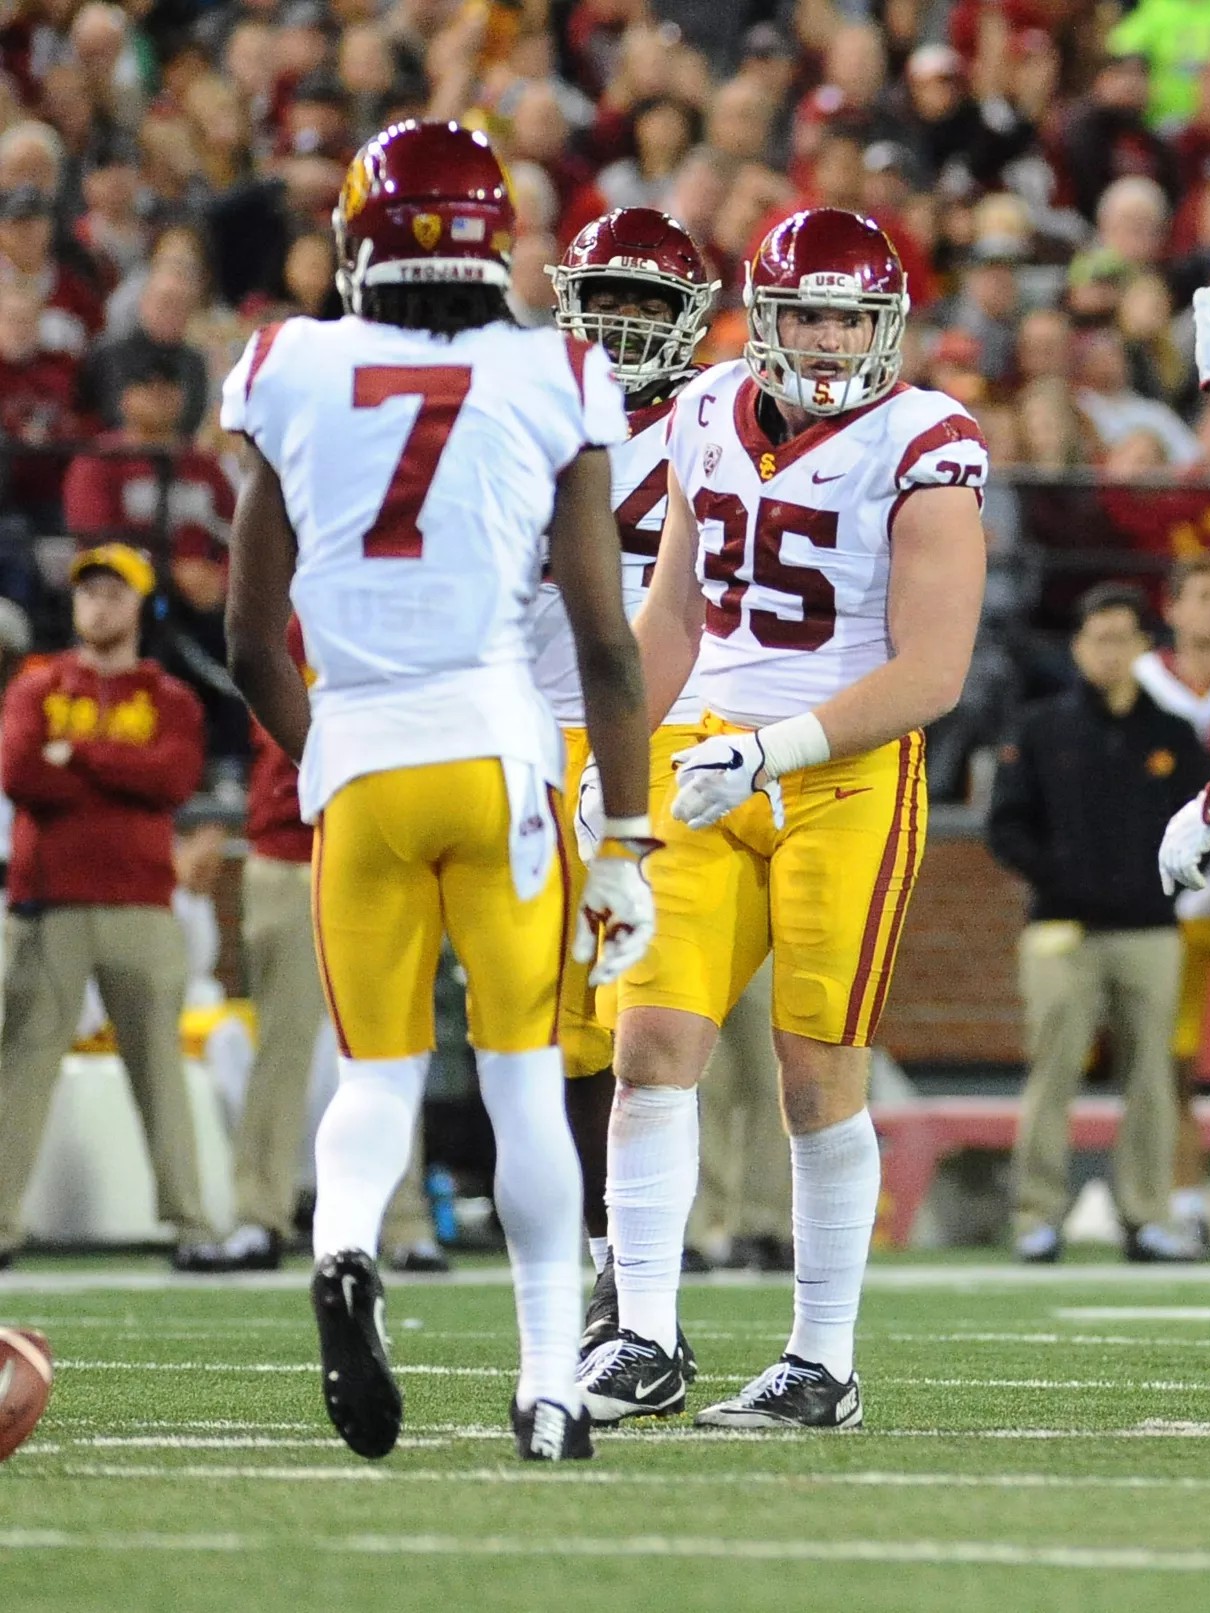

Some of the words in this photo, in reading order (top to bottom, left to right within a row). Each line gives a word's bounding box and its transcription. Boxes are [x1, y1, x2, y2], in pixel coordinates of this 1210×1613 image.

[400, 264, 484, 281] TROJANS
[621, 256, 648, 270] USC
[815, 275, 846, 287] USC
[698, 394, 716, 427] C
[352, 365, 473, 558] 7
[836, 1387, 857, 1422] NIKE
[530, 1401, 566, 1460] NIKE
